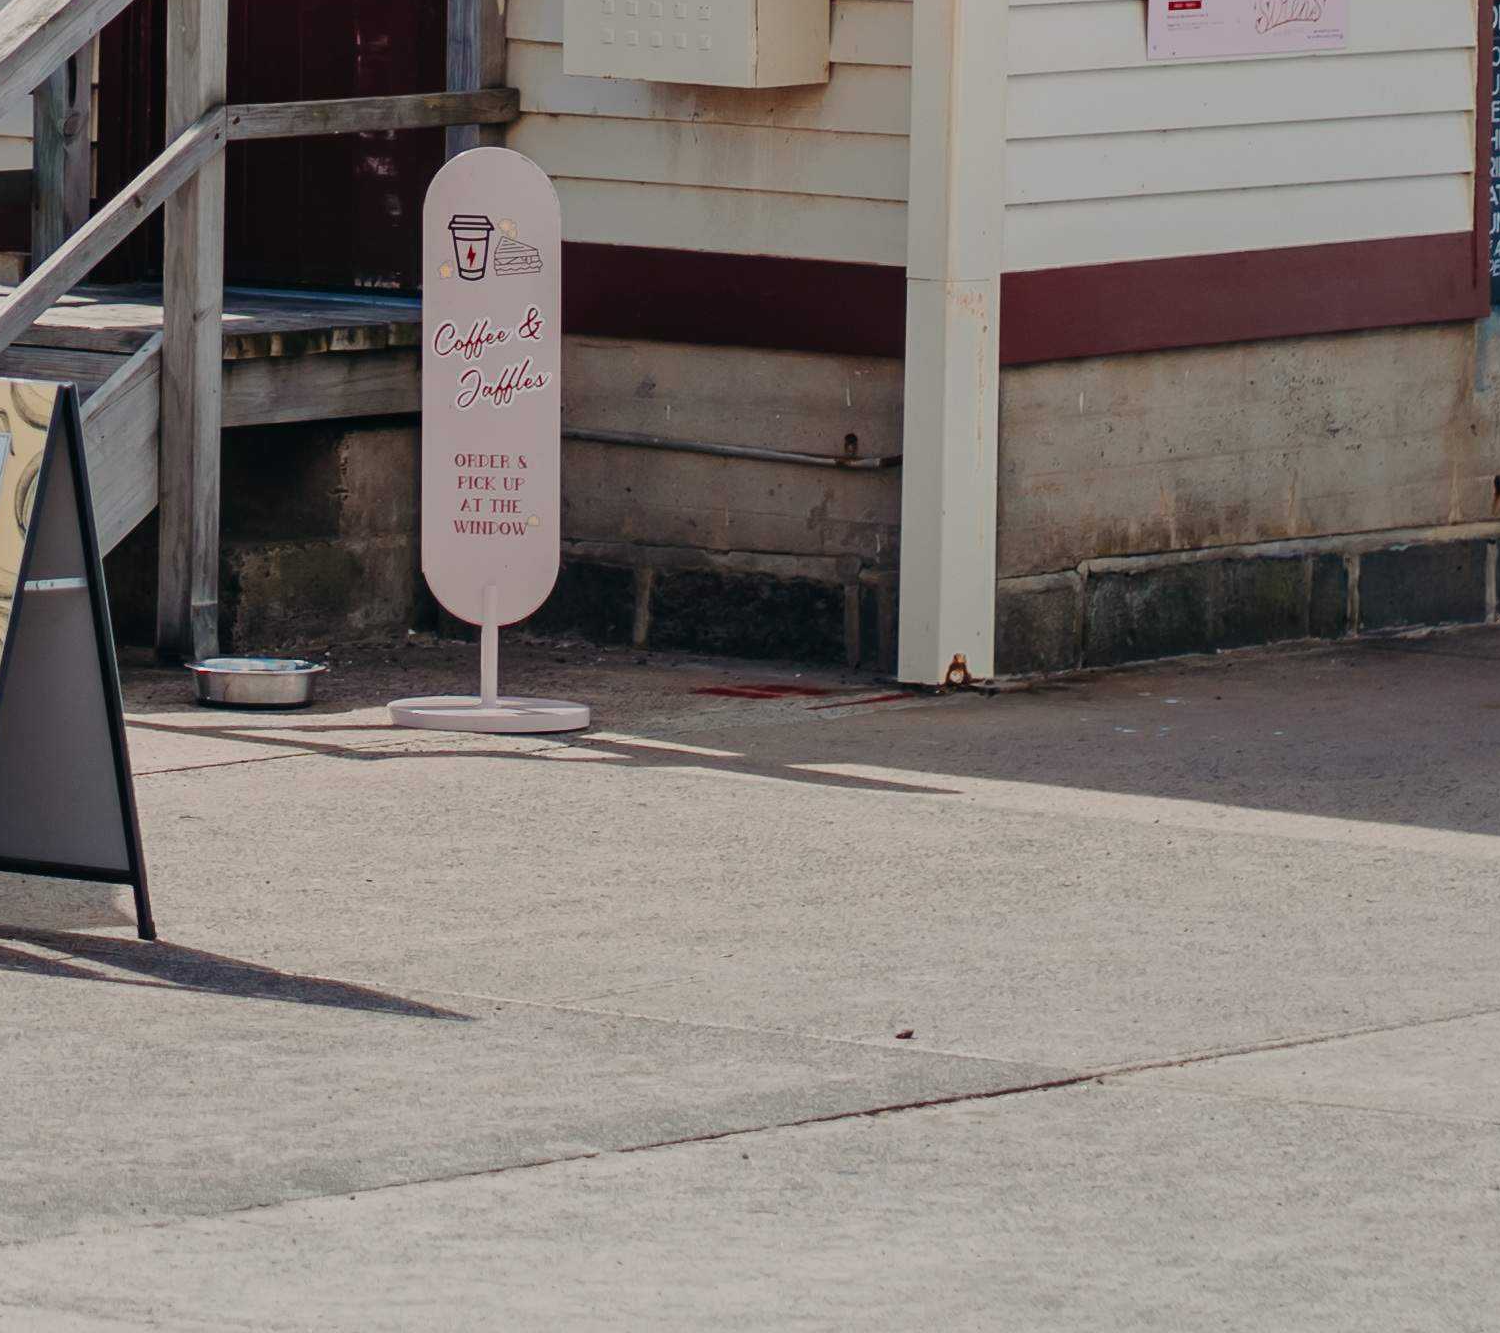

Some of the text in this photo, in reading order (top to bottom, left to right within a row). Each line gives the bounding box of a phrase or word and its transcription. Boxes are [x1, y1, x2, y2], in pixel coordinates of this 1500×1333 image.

[434, 307, 543, 360] Coffee &
[457, 359, 549, 408] Jaffles
[454, 453, 528, 470] ORDER &
[457, 475, 527, 491] PICK UP
[460, 497, 523, 513] AT THE
[453, 520, 528, 535] WINDOW
